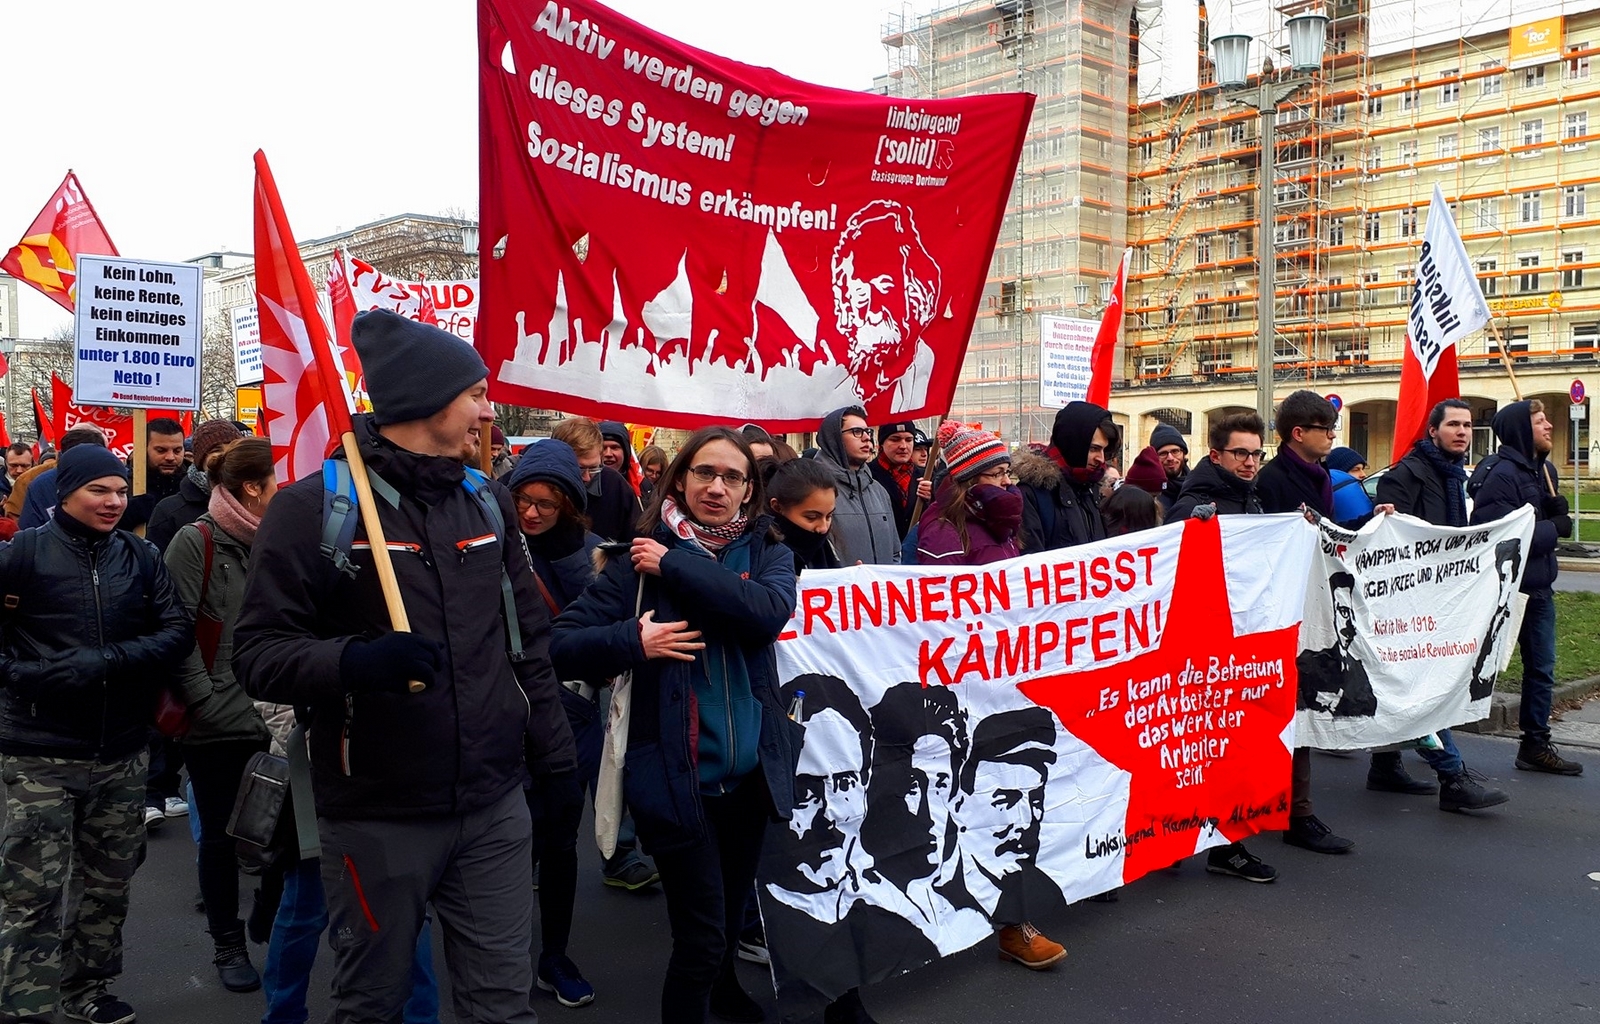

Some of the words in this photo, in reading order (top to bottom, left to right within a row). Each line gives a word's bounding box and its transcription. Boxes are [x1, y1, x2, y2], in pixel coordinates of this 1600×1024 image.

[531, 0, 616, 60] Aktiv
[623, 47, 724, 105] werden
[727, 89, 809, 127] gegen
[529, 64, 624, 127] dieses
[627, 101, 736, 162] System!
[886, 105, 962, 136] linksjugend
[527, 120, 693, 207] Sozialismus
[700, 189, 838, 233] erkämpfen!
[871, 169, 914, 186] Basisgruppe
[915, 173, 949, 187] Dortmund
[103, 265, 136, 282] Kein
[139, 268, 176, 286] Lohn,
[94, 285, 135, 302] keine
[138, 289, 184, 307] Rente,
[90, 306, 122, 322] kein
[125, 309, 186, 327] einziges
[1053, 321, 1082, 331] Kontrolle
[1083, 325, 1094, 333] der
[95, 327, 180, 346] Einkommen
[1044, 340, 1064, 350] durch
[1075, 344, 1093, 352] Arbei
[1052, 331, 1095, 343] Unternehmen
[79, 348, 119, 362] unter
[122, 350, 160, 365] 1.800
[163, 353, 195, 368] Euro
[1065, 354, 1087, 363] werden
[113, 370, 152, 386] Netto
[156, 373, 161, 386] !
[1053, 380, 1089, 391] Arbeitsplätz
[1056, 371, 1070, 380] Geld
[171, 396, 193, 404] Arbeiter
[1355, 547, 1397, 576] KÄMPFEN
[1414, 538, 1442, 561] ROSA
[1445, 534, 1467, 551] UND
[1023, 546, 1160, 609] HEISST
[1417, 567, 1433, 585] UND
[1435, 556, 1480, 584] KAPITAL!
[1411, 616, 1437, 633] 1918:
[917, 600, 1163, 690] KÄMPFEN!
[1426, 637, 1478, 658] Revolution!
[1127, 672, 1171, 703] kann
[1177, 658, 1204, 686] die
[1205, 653, 1285, 689] Befreiung
[1124, 703, 1156, 730] der
[1155, 684, 1234, 718] Arbeiter
[1240, 683, 1271, 702] nur
[1138, 721, 1170, 749] das
[1217, 708, 1246, 728] der
[1160, 733, 1230, 770] Arbeiter
[1085, 819, 1157, 859] Linksjugend
[1161, 808, 1220, 838] Hamburg
